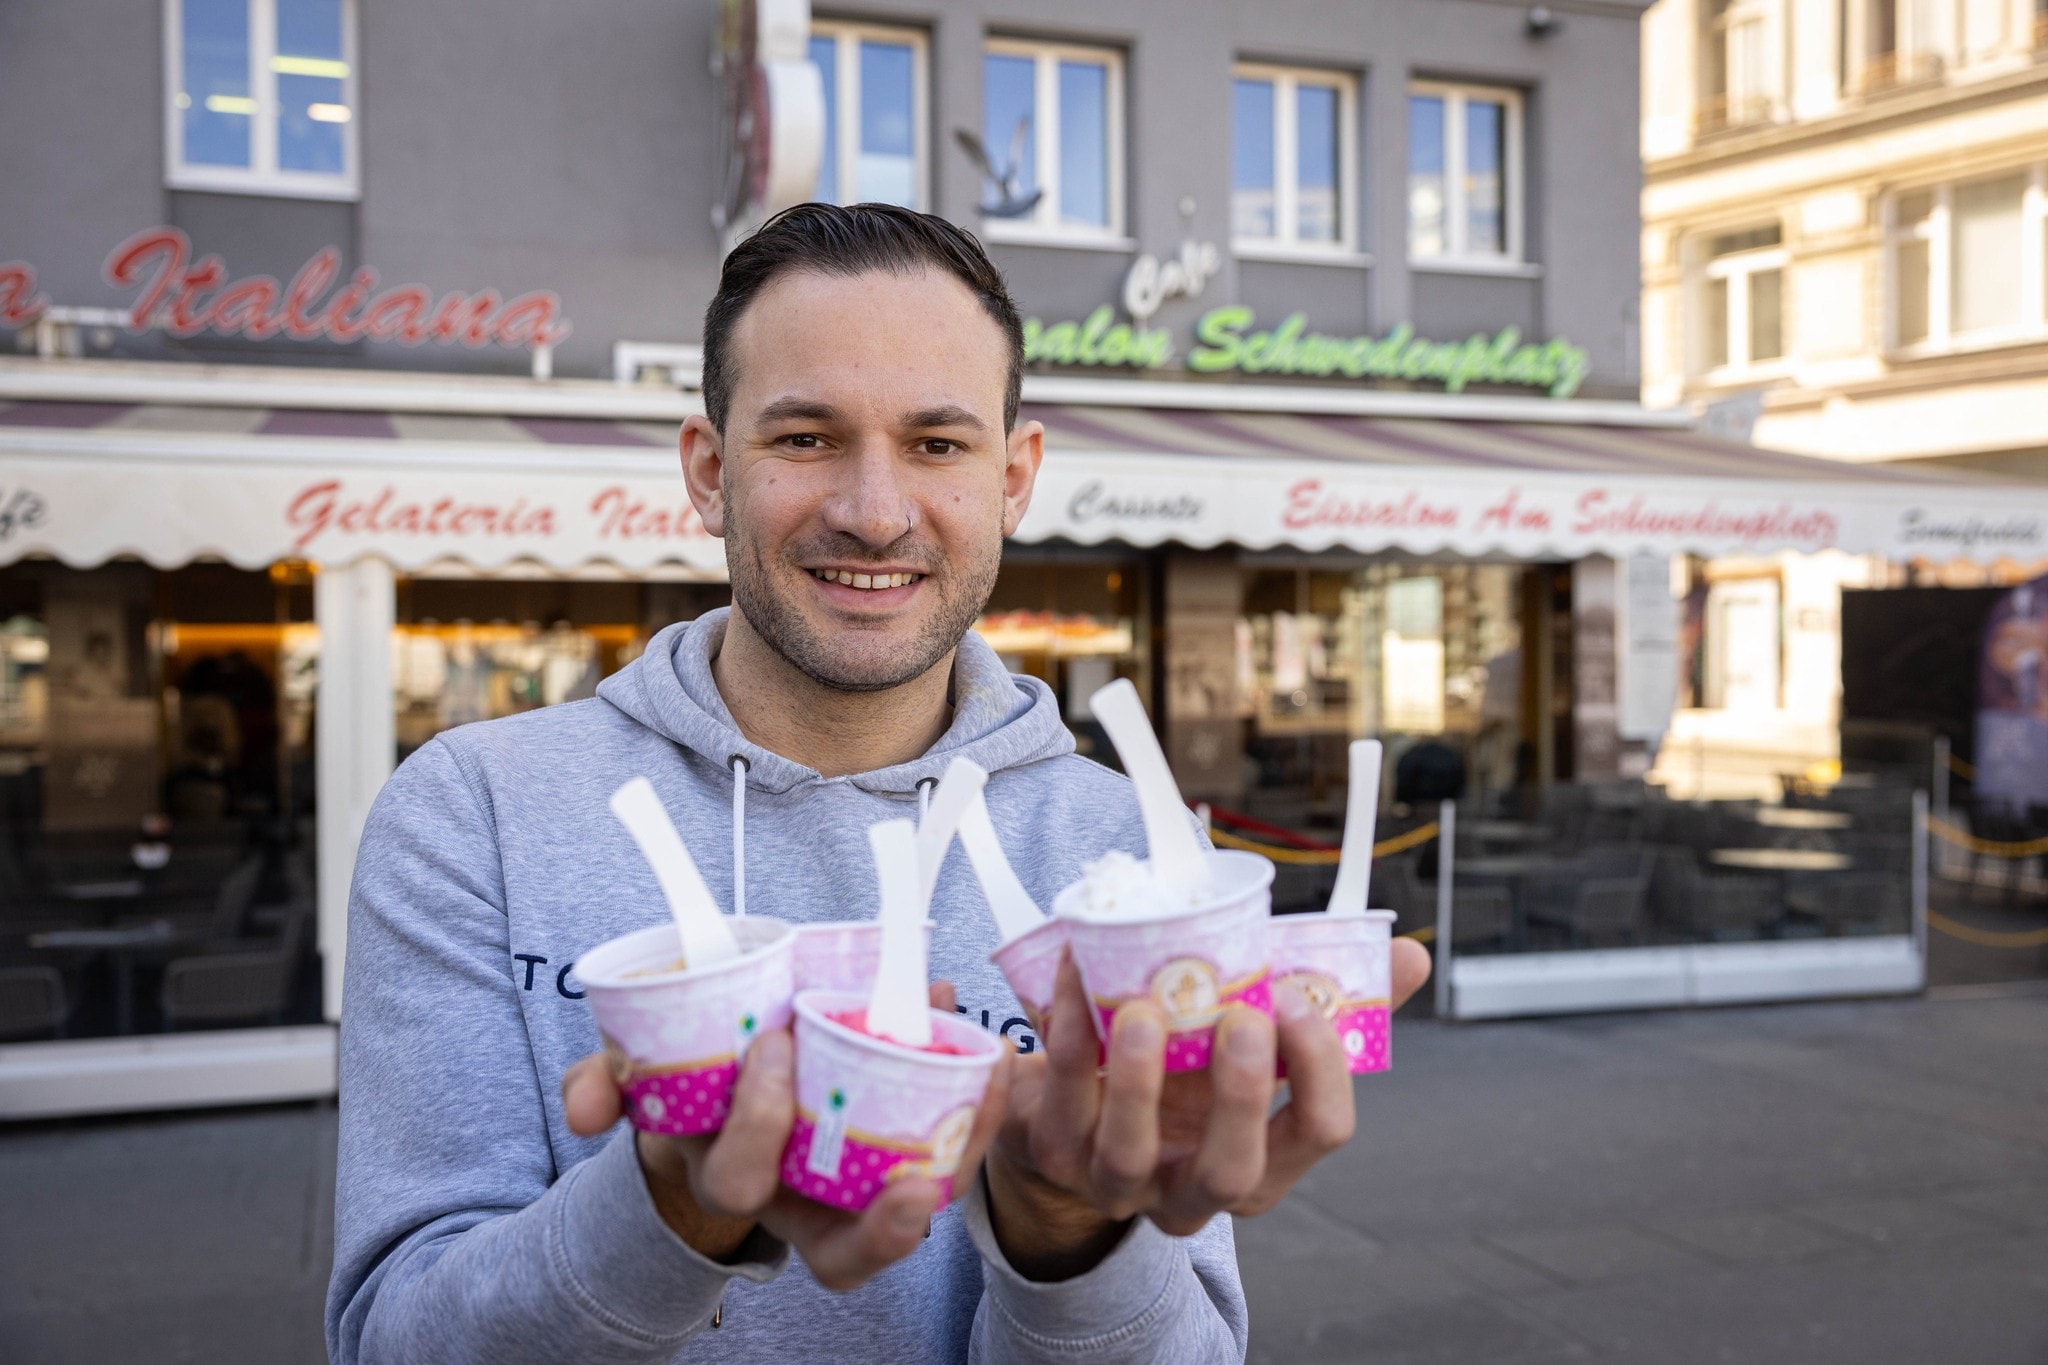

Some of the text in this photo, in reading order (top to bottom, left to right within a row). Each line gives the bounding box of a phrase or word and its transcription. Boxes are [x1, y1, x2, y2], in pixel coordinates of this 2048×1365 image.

[104, 226, 571, 347] Italiana
[1187, 306, 1590, 400] Schwedenplatz
[286, 479, 707, 552] Gelateria Ital
[1282, 478, 1839, 546] Eissalon Am Schwedenplatz
